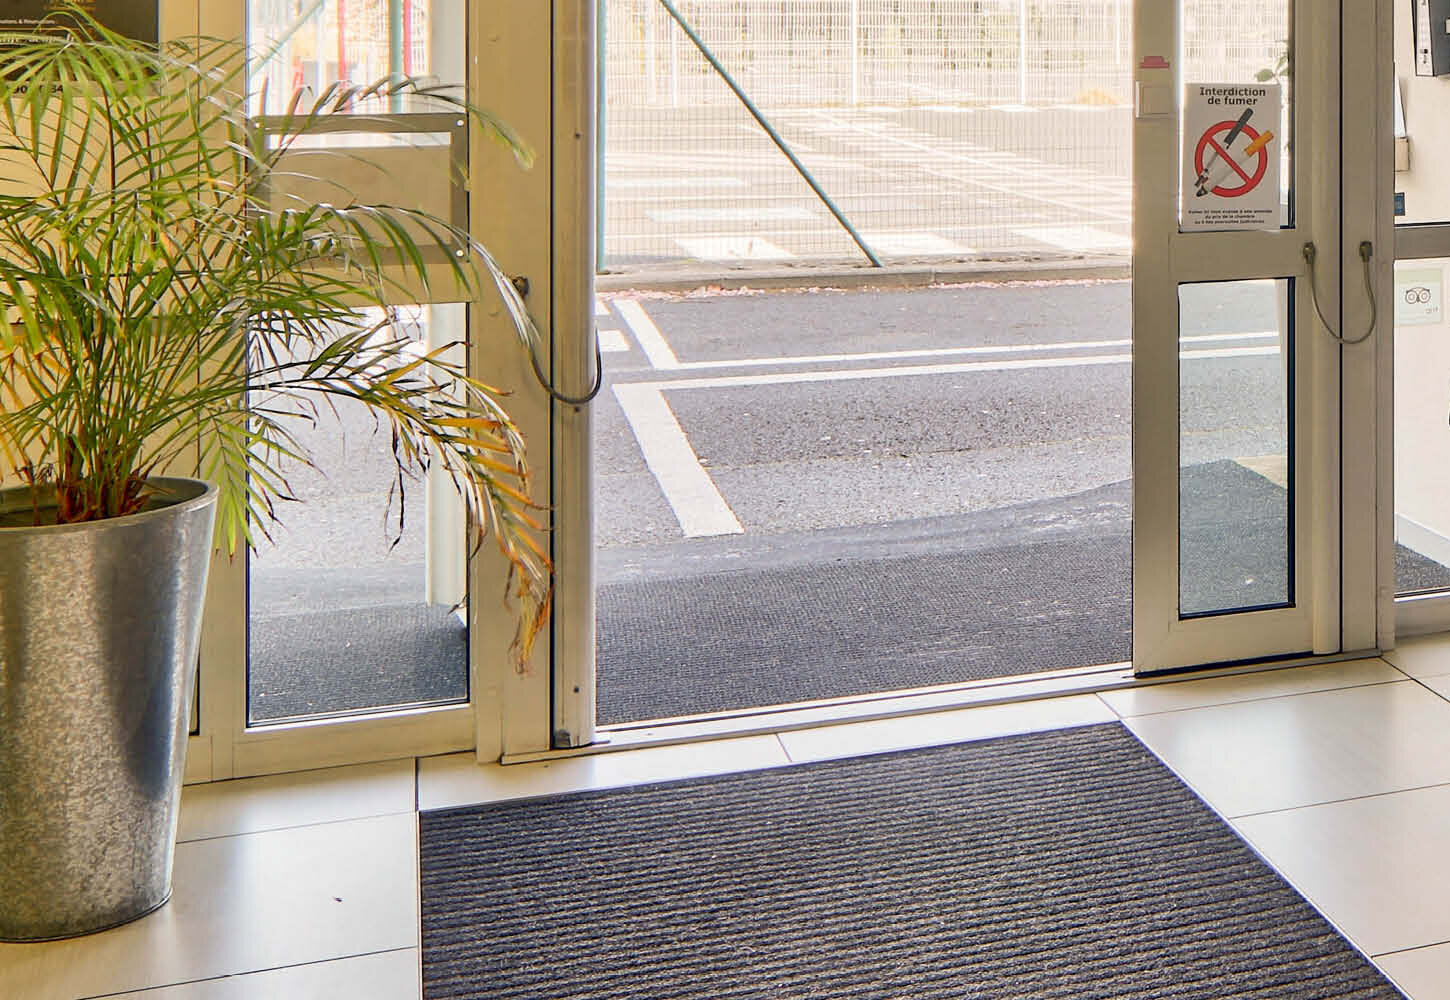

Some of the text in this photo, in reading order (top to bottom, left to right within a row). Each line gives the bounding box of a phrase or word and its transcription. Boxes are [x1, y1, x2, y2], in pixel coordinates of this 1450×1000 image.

[1200, 87, 1266, 96] Interdiction
[1208, 96, 1258, 105] de fumer
